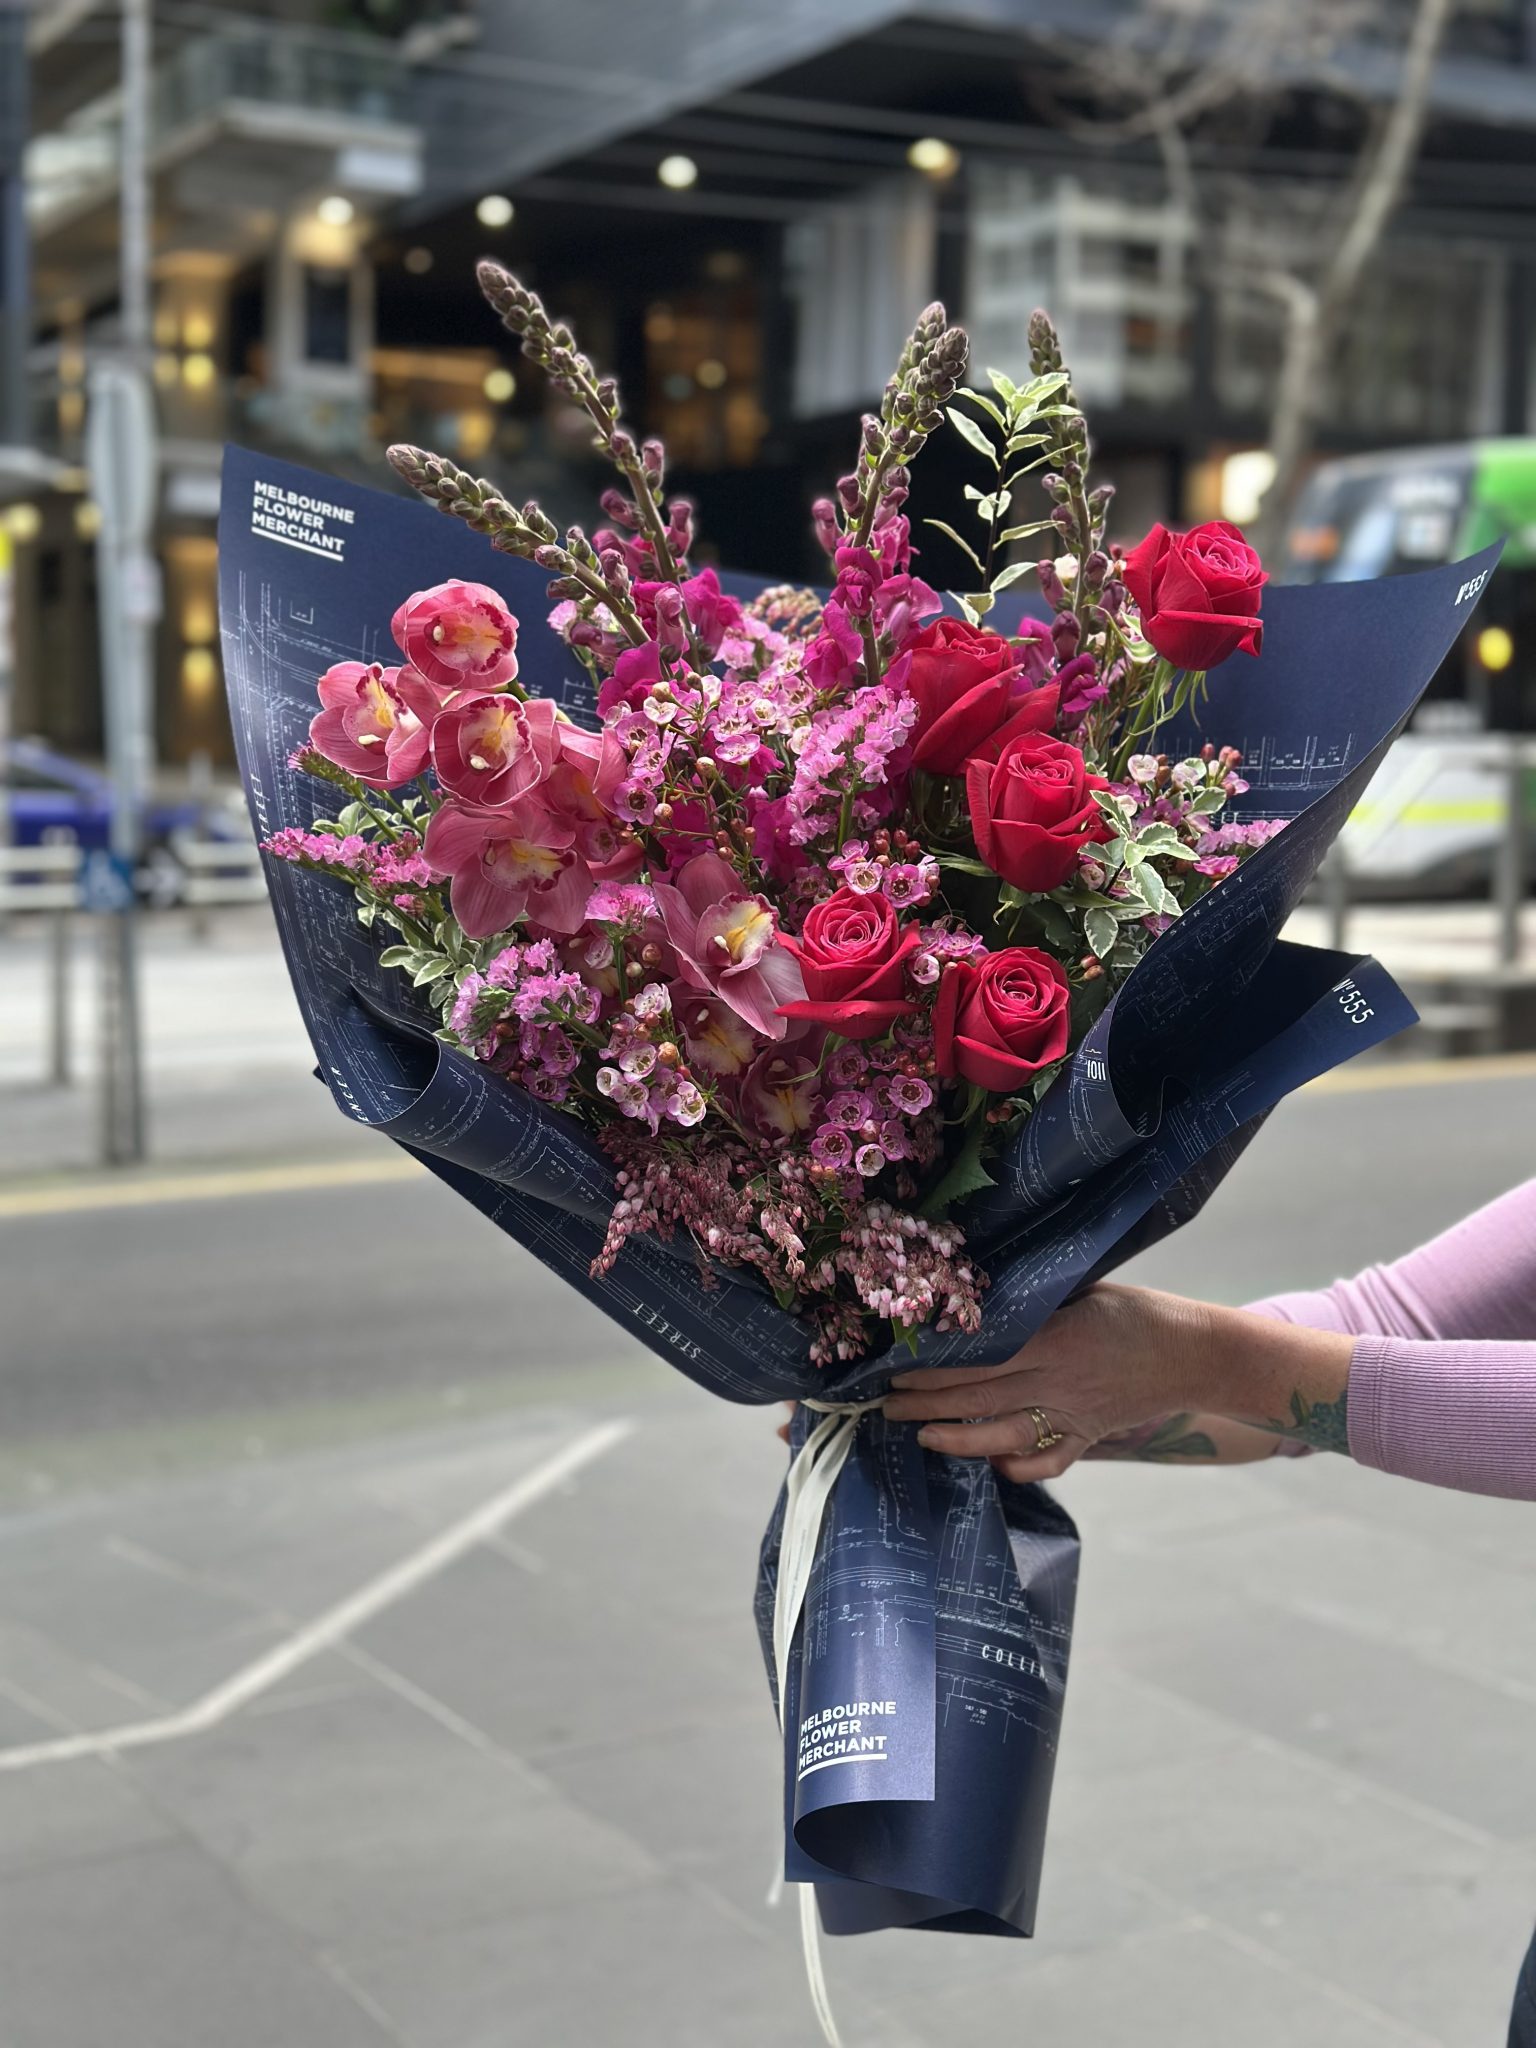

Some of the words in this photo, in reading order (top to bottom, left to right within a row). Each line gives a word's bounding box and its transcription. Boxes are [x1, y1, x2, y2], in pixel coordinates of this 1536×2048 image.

[253, 495, 325, 530] FLOWER
[254, 480, 355, 524] MELBOURNE
[252, 511, 345, 552] MERCHANT
[1169, 874, 1246, 936] STREET
[633, 1303, 701, 1359] STREET
[800, 1719, 862, 1753] FLOWER
[801, 1701, 897, 1737] MELBOURNE
[799, 1736, 887, 1771] MERCHANT
